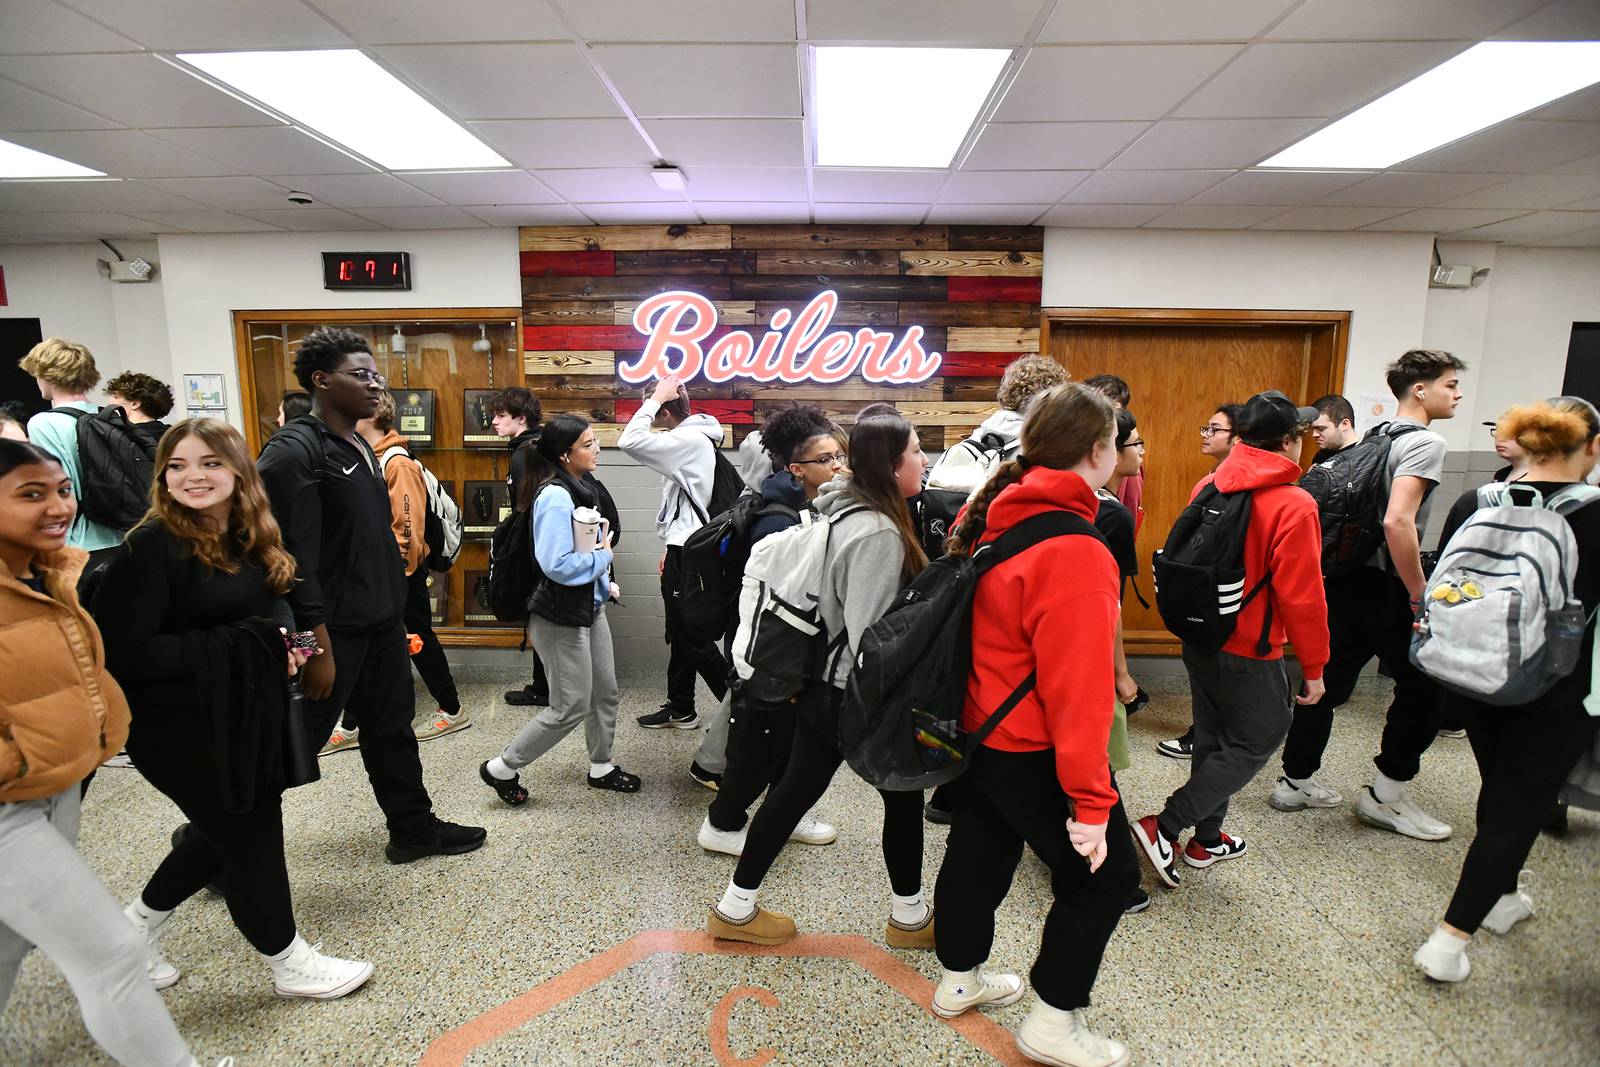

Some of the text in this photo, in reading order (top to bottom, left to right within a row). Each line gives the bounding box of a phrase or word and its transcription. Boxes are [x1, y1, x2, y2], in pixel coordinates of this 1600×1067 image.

[618, 290, 943, 384] Boilers
[403, 407, 423, 415] 2017
[479, 397, 489, 427] IHSA
[708, 985, 781, 1067] C
